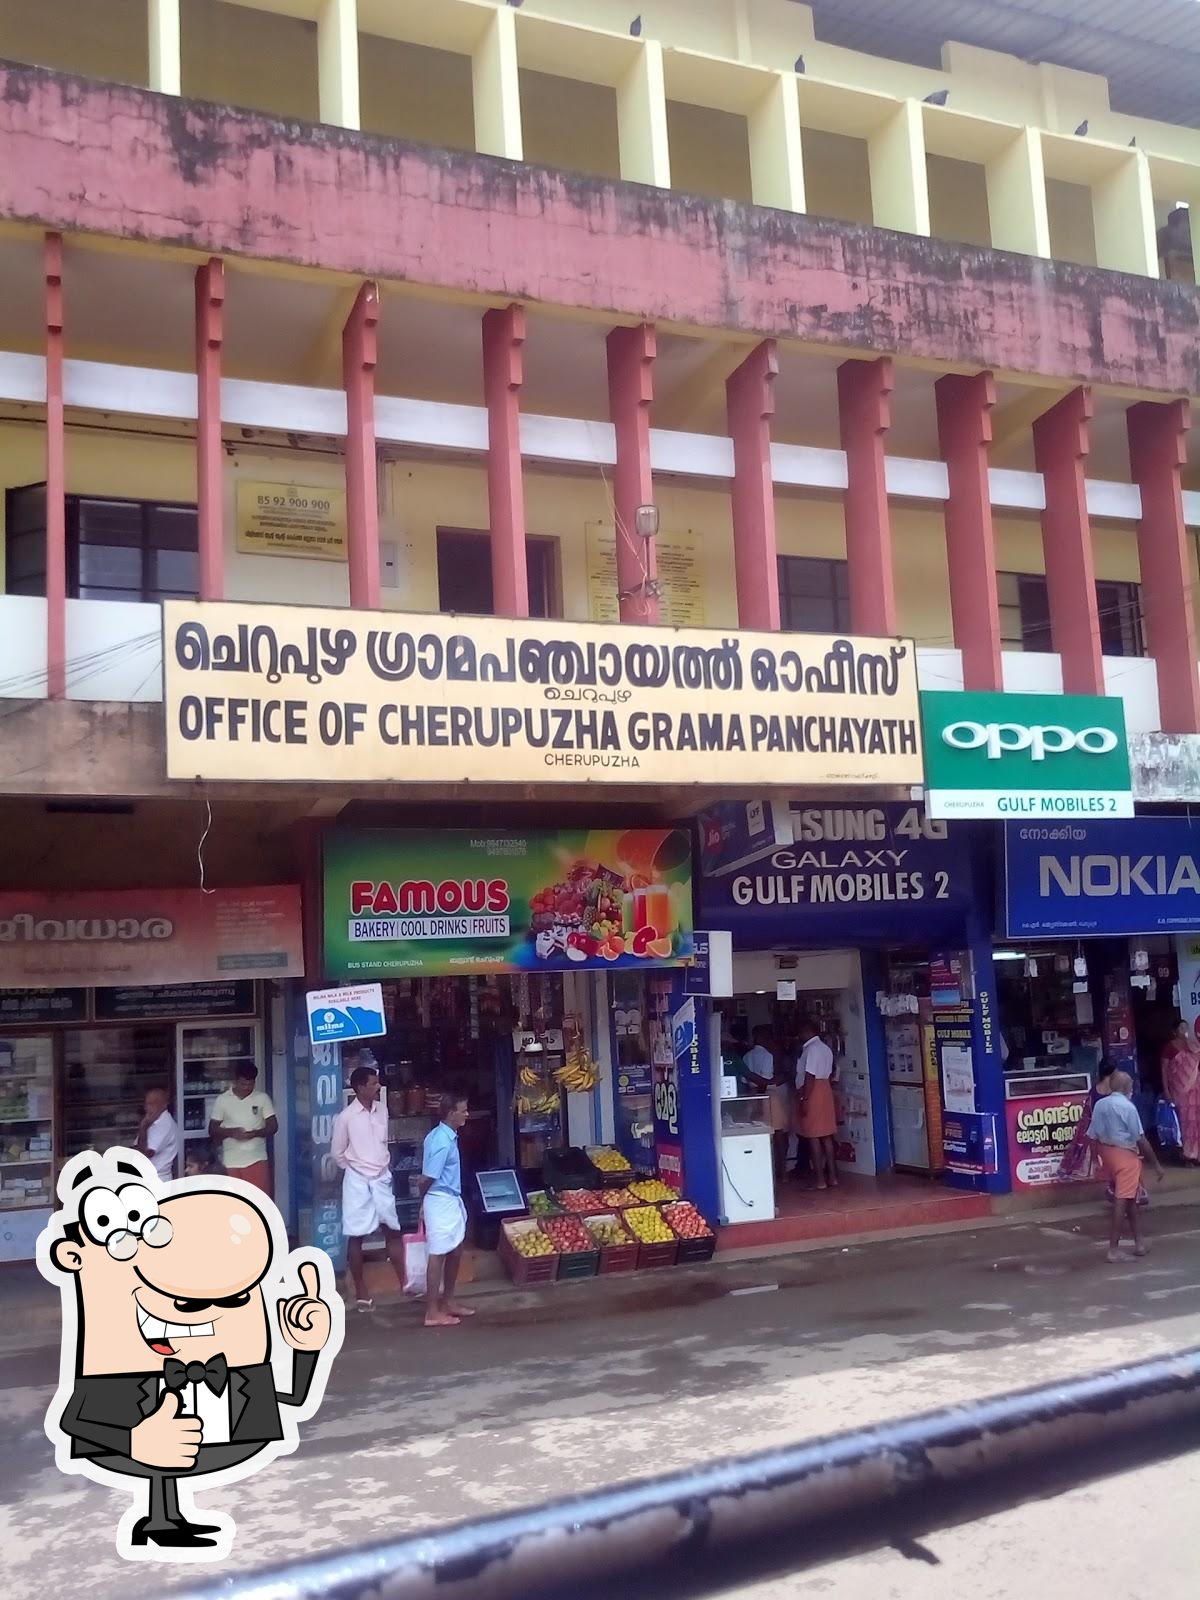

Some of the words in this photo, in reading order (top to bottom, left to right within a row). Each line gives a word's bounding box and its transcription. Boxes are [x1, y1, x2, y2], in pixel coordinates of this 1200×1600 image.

[273, 496, 285, 506] 92
[289, 498, 307, 508] 900
[311, 500, 330, 510] 900
[175, 621, 357, 684] ചെറുപുഴ
[367, 630, 743, 691] ഗ്രാമപഞ്ചായത്ത്
[750, 639, 906, 696] ഓഫീസ്
[544, 687, 632, 705] ചെറുപുഴ
[179, 695, 308, 745] OFFICE
[319, 701, 367, 746] OF
[378, 703, 621, 750] CHERUPUZHA
[628, 711, 746, 752] GRAMA
[750, 715, 917, 755] PANCHAYATH
[544, 753, 640, 768] CHERUPUZHA
[997, 797, 1036, 812] GULF
[1041, 797, 1104, 812] MOBILES
[1109, 798, 1117, 812] 2
[790, 808, 886, 841] SUNG
[1019, 825, 1086, 841] നോക്കിയ
[771, 850, 909, 869] GALAXY
[1039, 855, 1200, 896] NOKIA
[732, 874, 804, 905] GULF
[810, 872, 924, 901] MOBILES
[934, 871, 949, 899] 2
[354, 922, 395, 938] BAKERY
[401, 921, 428, 937] COOL
[430, 919, 467, 936] DRINKS
[473, 918, 506, 935] FRUITS
[982, 1017, 993, 1053] MOBILE
